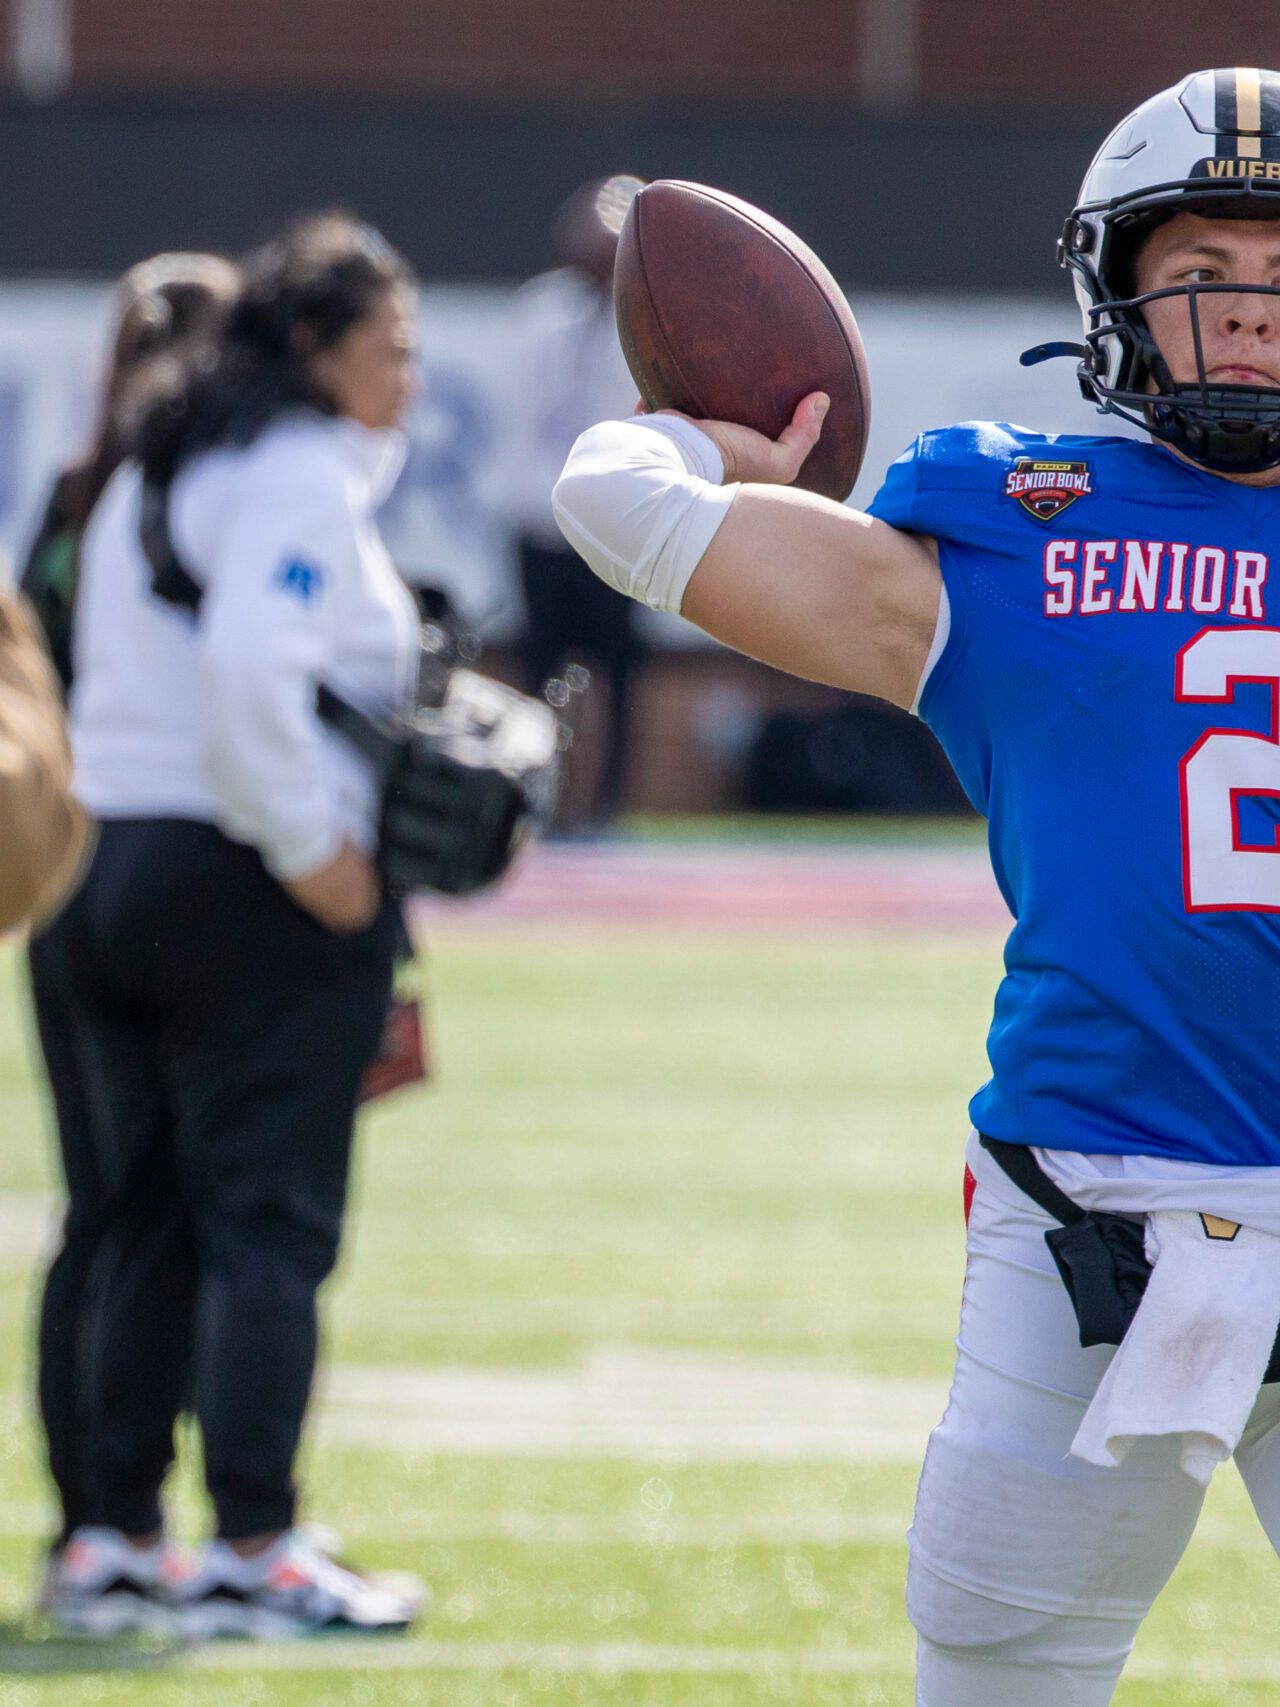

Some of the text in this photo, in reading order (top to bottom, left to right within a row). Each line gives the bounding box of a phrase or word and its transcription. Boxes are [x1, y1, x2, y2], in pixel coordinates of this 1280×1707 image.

[1006, 471, 1092, 495] SENIOR BOWL
[1043, 539, 1267, 619] SENIOR
